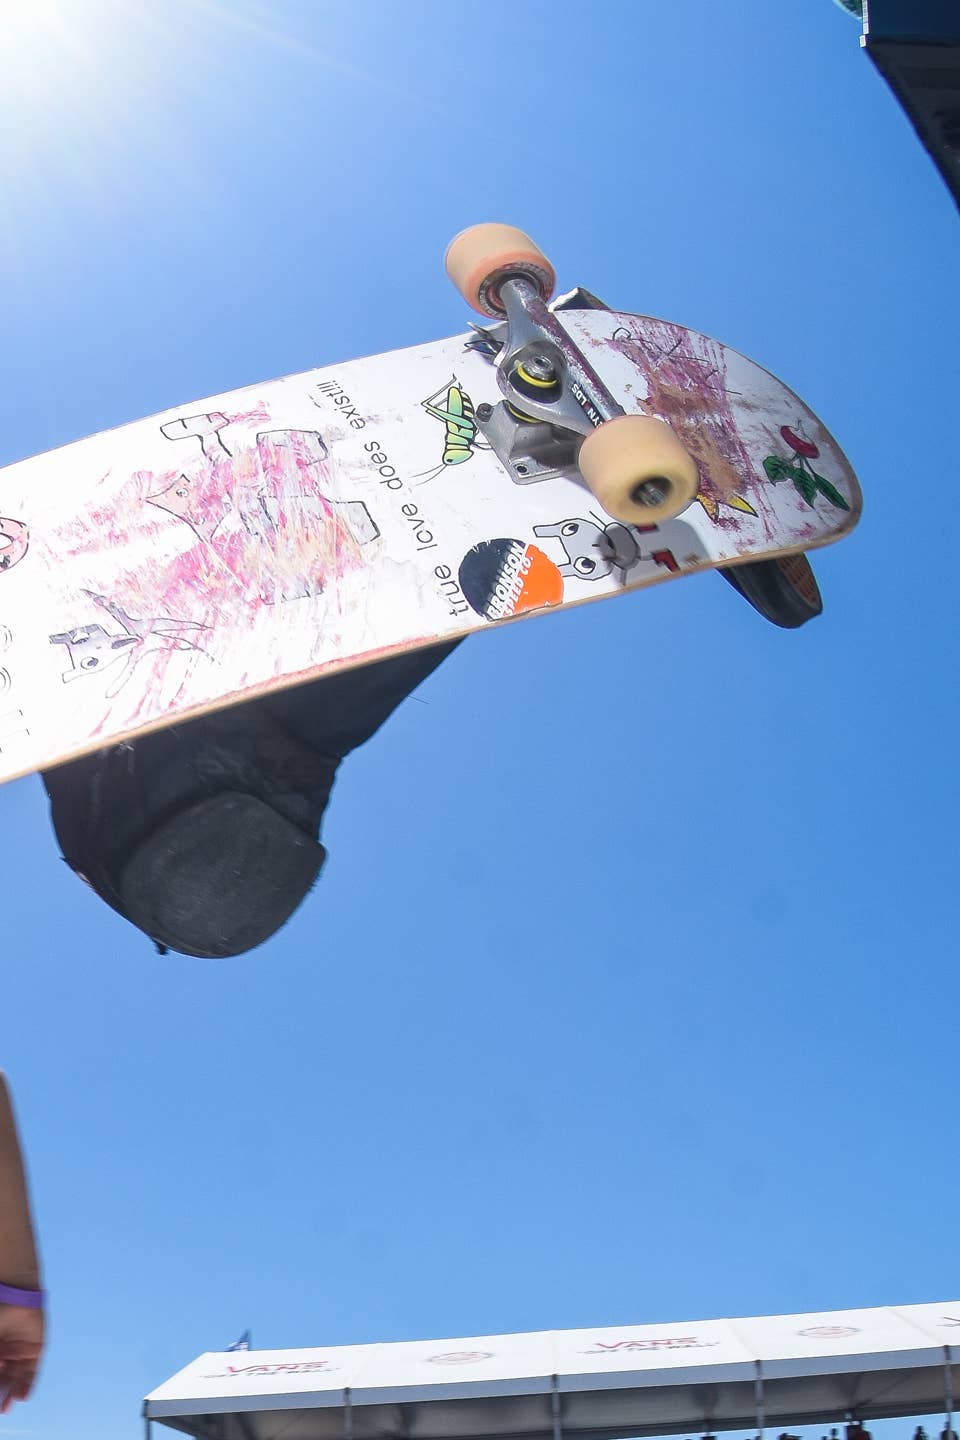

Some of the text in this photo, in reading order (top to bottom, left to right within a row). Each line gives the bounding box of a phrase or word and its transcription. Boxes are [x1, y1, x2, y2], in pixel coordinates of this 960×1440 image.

[363, 441, 403, 490] does
[401, 503, 438, 551] love
[434, 564, 469, 616] true
[486, 541, 526, 620] BRONSON
[502, 556, 534, 617] SPEED CO.
[227, 1360, 329, 1373] VANS
[593, 1337, 697, 1348] VANS
